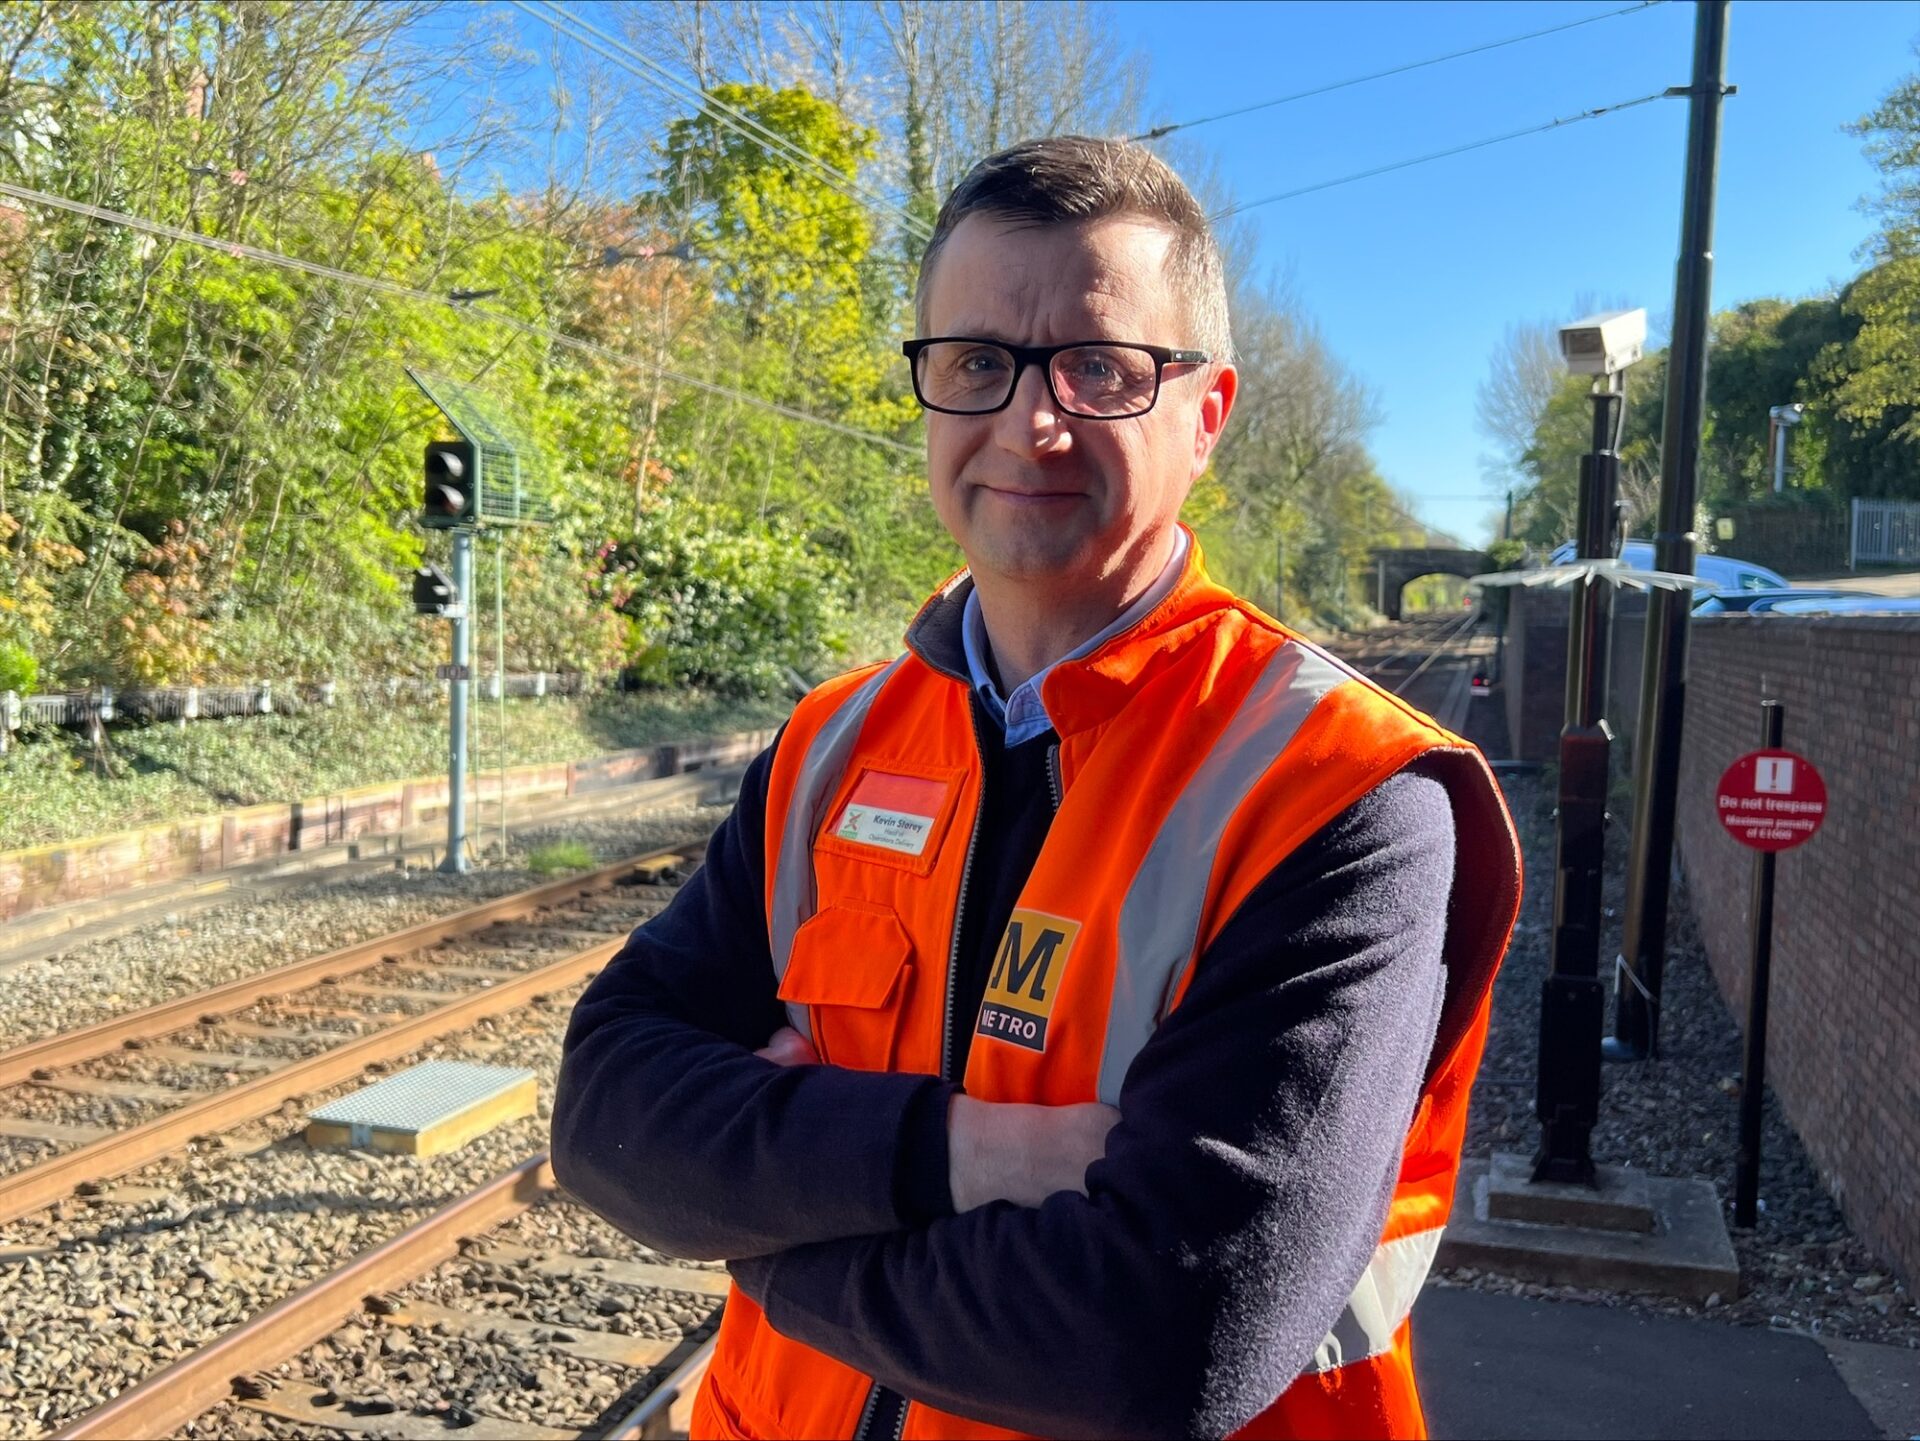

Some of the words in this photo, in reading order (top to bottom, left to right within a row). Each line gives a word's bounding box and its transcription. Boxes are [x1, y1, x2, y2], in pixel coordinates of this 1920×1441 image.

[1719, 795, 1738, 809] Do
[1741, 797, 1762, 811] not
[1766, 798, 1823, 814] trespass
[873, 815, 896, 826] Kevin
[896, 819, 923, 833] Storey
[1725, 814, 1774, 828] Maximum
[1775, 818, 1815, 832] penalty
[990, 921, 1065, 1002] M
[981, 1009, 1037, 1039] METRO
